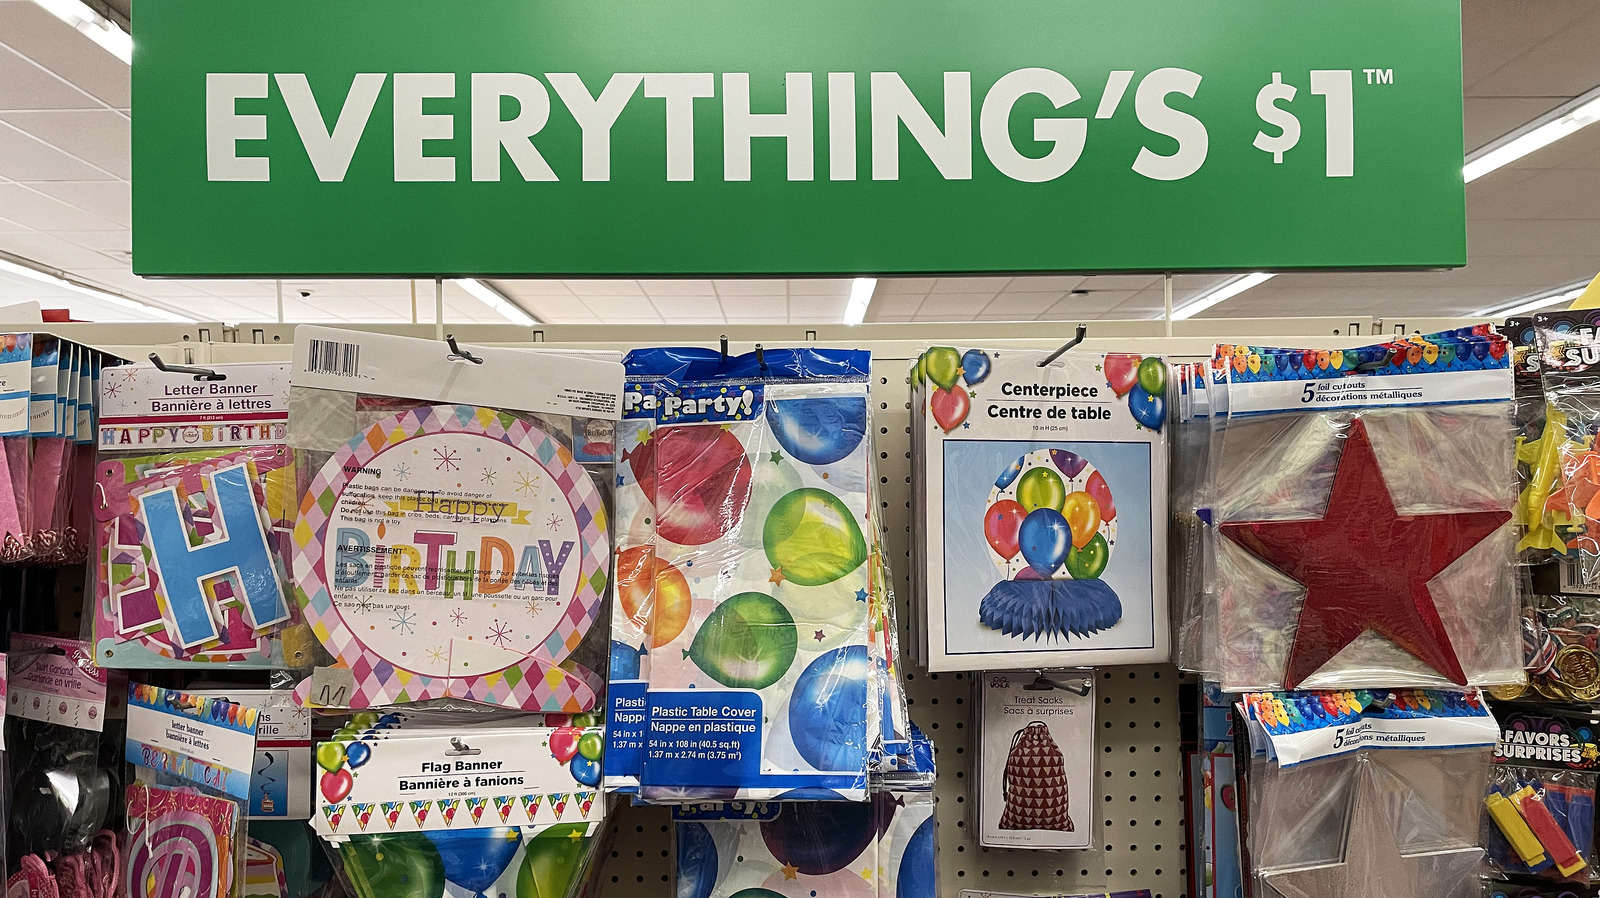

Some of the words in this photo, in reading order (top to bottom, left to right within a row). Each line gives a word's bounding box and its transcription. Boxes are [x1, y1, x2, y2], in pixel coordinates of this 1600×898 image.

[206, 67, 1209, 183] EVERYTHING'S
[164, 384, 205, 396] Letter
[209, 383, 258, 395] Banner
[1001, 382, 1099, 399] Centerpiece
[1301, 382, 1316, 403] 5
[1317, 383, 1331, 391] foil
[1332, 381, 1366, 391] cutouts
[664, 389, 754, 417] Party!
[1315, 392, 1368, 403] décorations
[1370, 391, 1423, 400] métalliques
[151, 400, 212, 413] Bannière
[217, 399, 224, 410] à
[228, 399, 272, 411] lettres
[987, 404, 1043, 420] Centre
[1046, 404, 1068, 420] de
[1071, 405, 1112, 421] table
[101, 427, 179, 445] HAPPY
[343, 465, 382, 476] WARNING
[342, 482, 363, 490] Plastic
[364, 484, 379, 492] bags
[463, 491, 485, 499] danger
[413, 490, 509, 524] Happy
[336, 544, 404, 555] AVERTISSEMENT
[54, 678, 63, 687] en
[1014, 696, 1035, 704] Treat
[1037, 696, 1064, 705] Sacks
[651, 706, 688, 717] Plastic
[691, 706, 718, 717] Table
[721, 706, 757, 718] Cover
[1003, 706, 1025, 715] Sacs
[1026, 707, 1033, 715] à
[1035, 708, 1074, 716] surprises
[171, 720, 186, 731] letter
[186, 724, 204, 736] banner
[612, 730, 621, 738] 54
[623, 730, 631, 738] in
[651, 721, 686, 734] Nappe
[688, 723, 701, 732] en
[703, 721, 756, 735] plastique
[1345, 727, 1355, 736] foil
[165, 729, 188, 744] bannière
[193, 736, 210, 750] lettres
[612, 740, 627, 748] 1.37
[648, 740, 658, 748] 54
[659, 740, 667, 748] in
[675, 740, 689, 748] 108
[690, 740, 697, 748] in
[699, 740, 718, 750] (40.5
[718, 740, 740, 750] sq.ft)
[1333, 728, 1346, 749] 5
[1375, 733, 1426, 743] métalliques
[1505, 730, 1570, 747] FAVORS
[648, 750, 664, 759] 1.37
[680, 750, 696, 759] 2.74
[707, 751, 726, 761] (3.75
[1494, 744, 1582, 763] SURPRISES
[421, 762, 451, 774] Flag
[455, 760, 503, 771] Banner
[399, 777, 460, 791] Bannière
[463, 776, 471, 788] à
[475, 775, 524, 787] fanions
